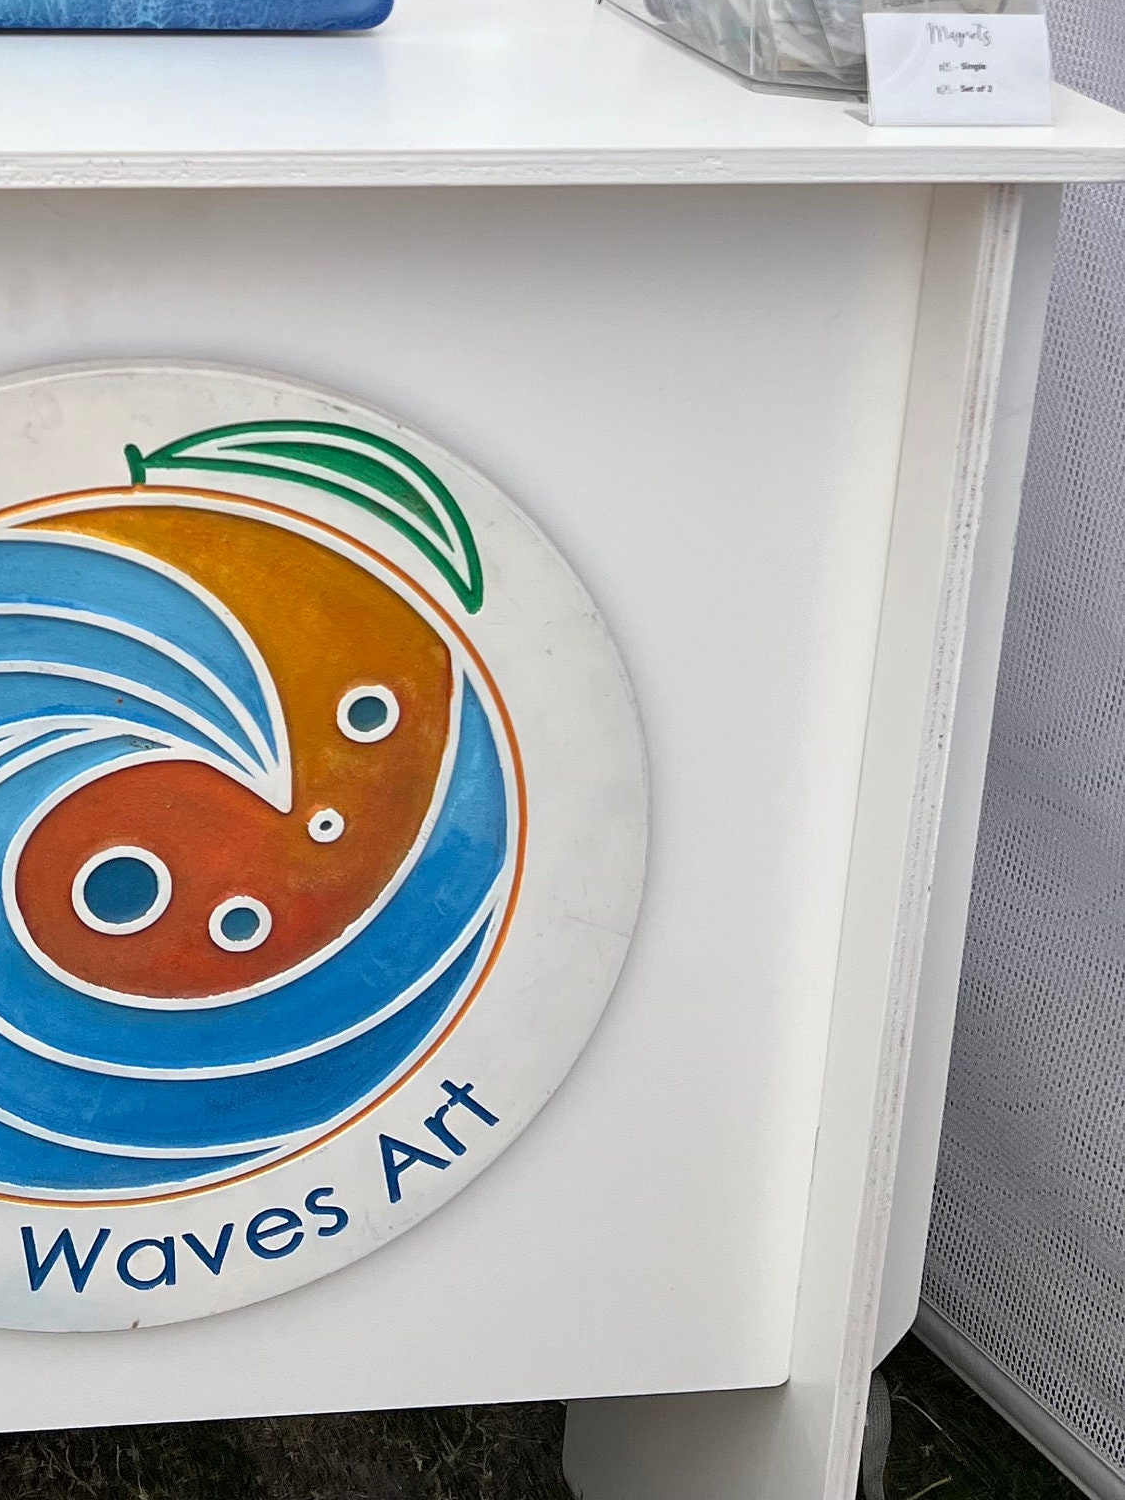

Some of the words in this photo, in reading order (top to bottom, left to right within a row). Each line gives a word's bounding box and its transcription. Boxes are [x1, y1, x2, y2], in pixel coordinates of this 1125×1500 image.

[927, 22, 992, 48] Magnets
[21, 1187, 350, 1295] Waves
[378, 1078, 500, 1205] Art
